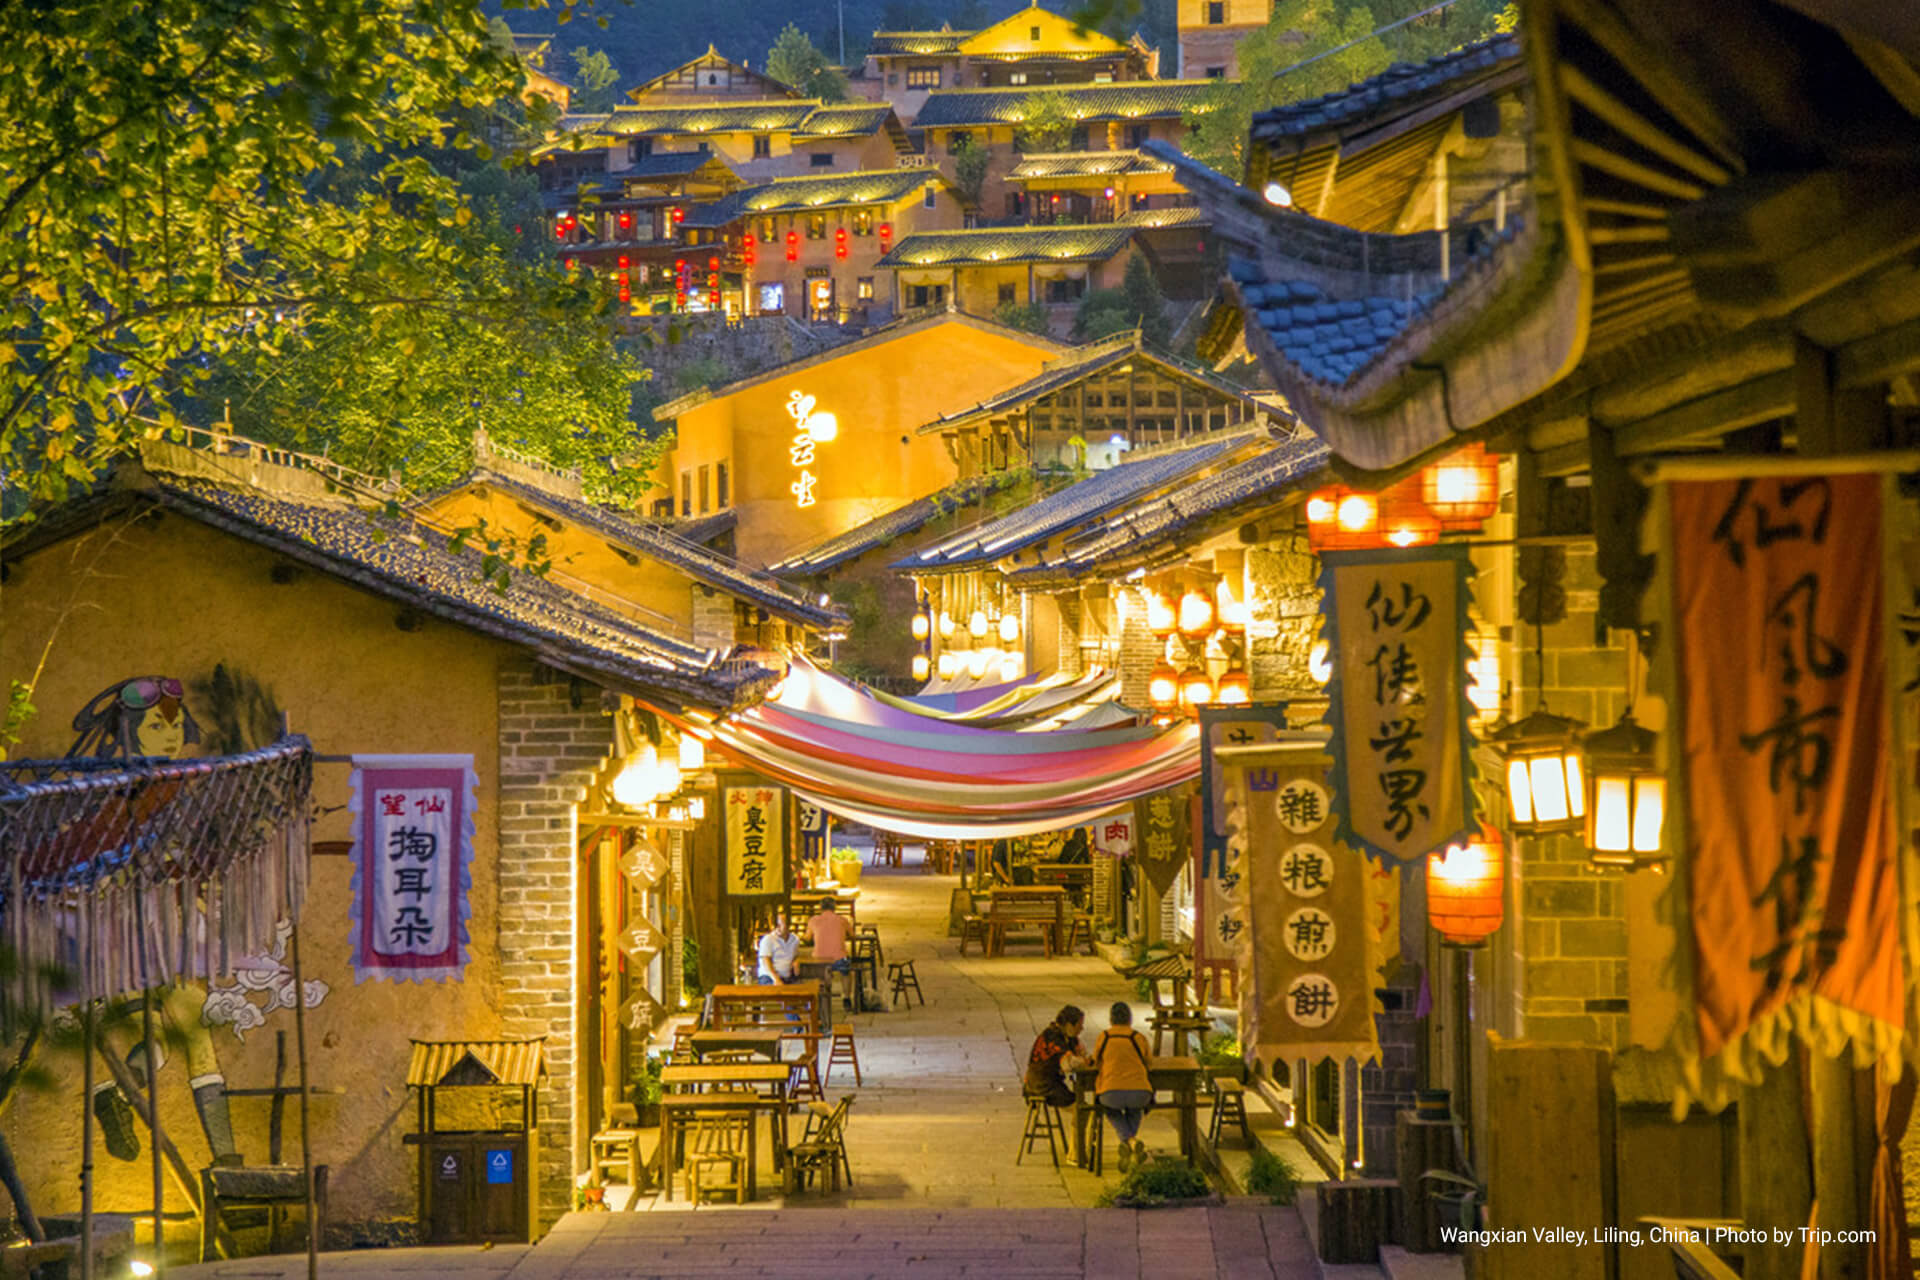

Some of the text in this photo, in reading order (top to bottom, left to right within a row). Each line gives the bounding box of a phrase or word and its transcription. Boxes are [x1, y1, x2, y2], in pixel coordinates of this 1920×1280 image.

[380, 794, 446, 816] 望仙
[739, 805, 767, 890] 臭豆腐
[1105, 820, 1128, 842] 肉
[389, 825, 438, 947] 掏耳朵
[630, 850, 657, 1029] 臭豆腐
